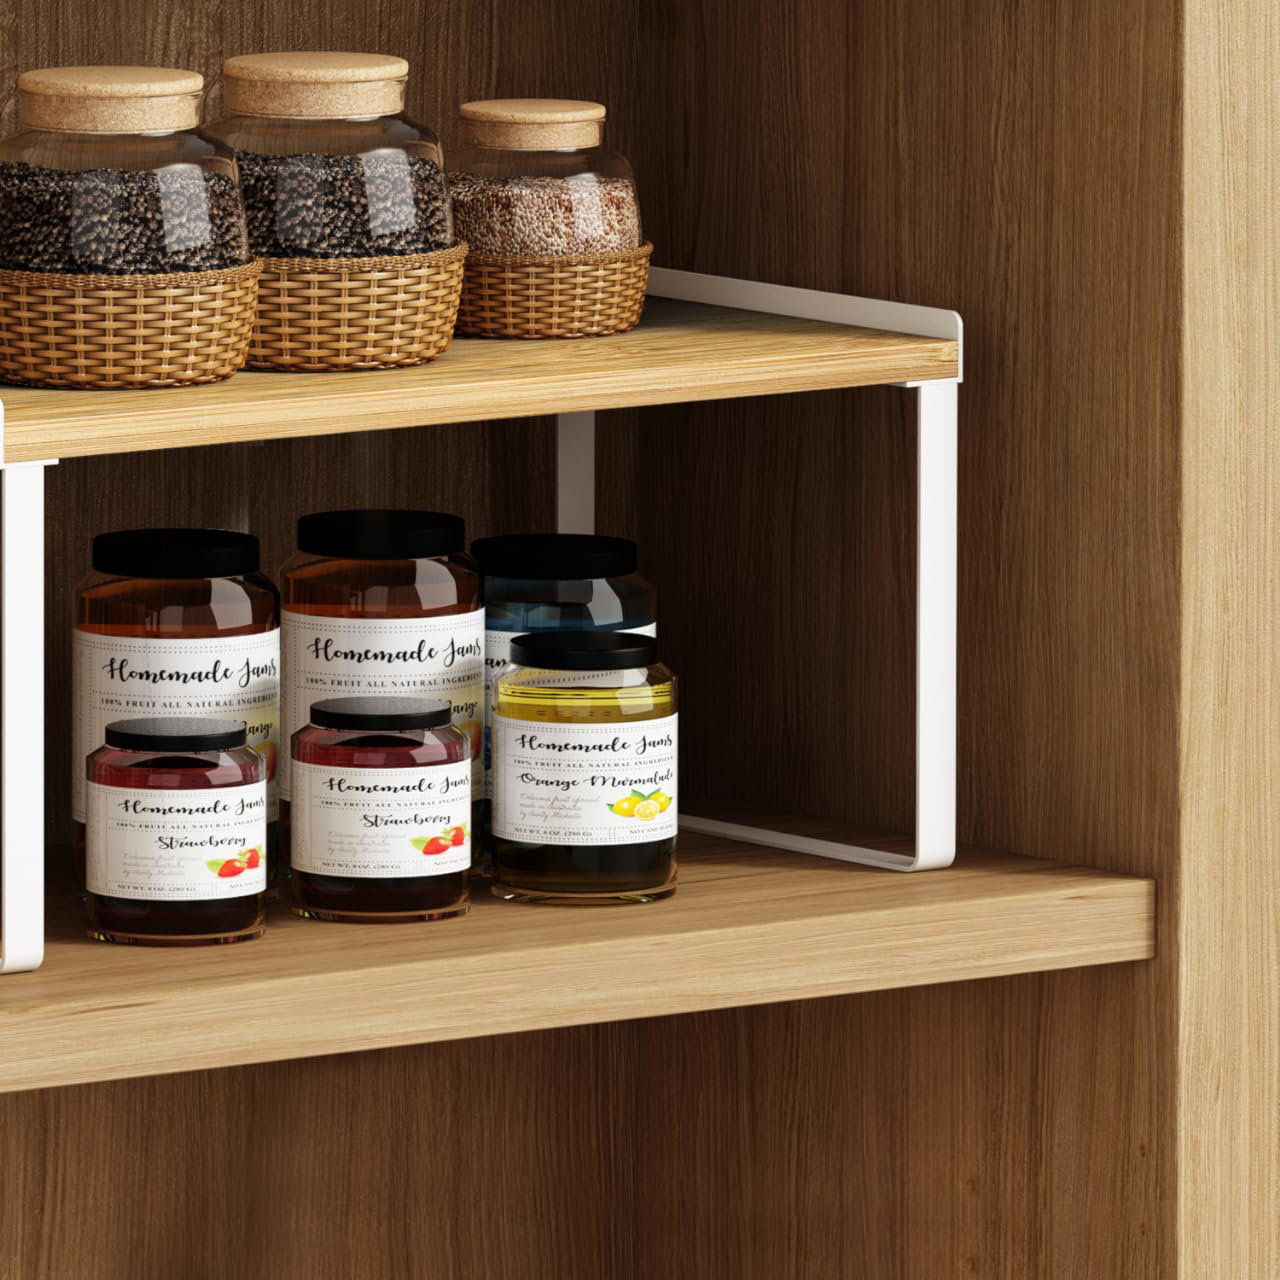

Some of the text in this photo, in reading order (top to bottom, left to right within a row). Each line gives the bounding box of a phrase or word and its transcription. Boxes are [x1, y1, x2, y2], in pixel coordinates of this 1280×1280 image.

[307, 637, 439, 664] Homemade
[443, 637, 481, 668] Jams
[102, 657, 276, 688] Homemade Jams
[305, 677, 327, 686] 100%
[331, 679, 361, 687] FRUIT
[367, 680, 387, 688] ALL
[391, 678, 437, 688] NATURAL
[101, 697, 122, 706] 100%
[126, 700, 156, 708] FRUIT
[187, 699, 234, 708] NATURAL
[514, 734, 673, 755] Homemade Jams
[322, 775, 469, 794] Homemade Jams
[516, 772, 579, 791] Orange
[117, 795, 265, 816] Homemade Jams
[359, 813, 451, 828] Strawberry
[153, 835, 246, 850] Strawberry
